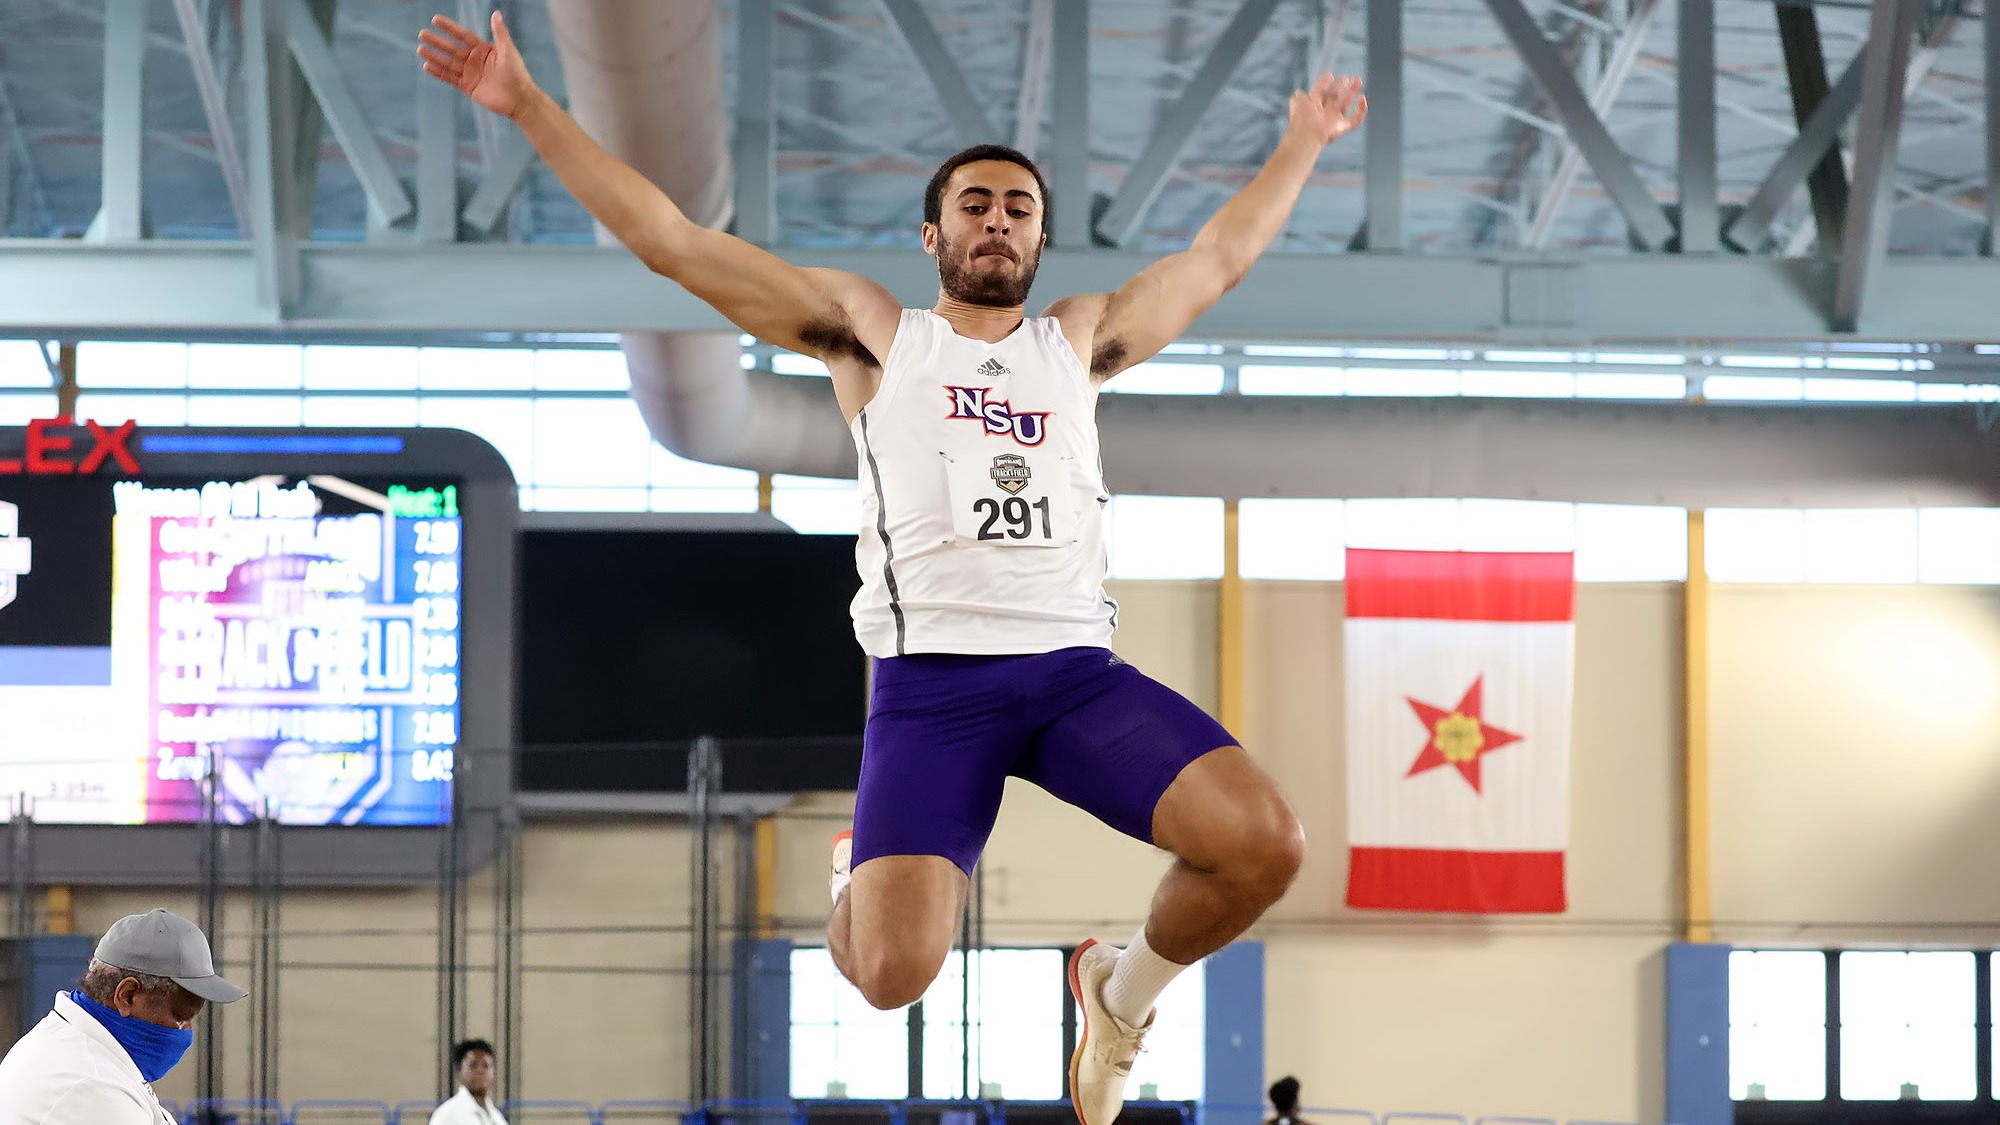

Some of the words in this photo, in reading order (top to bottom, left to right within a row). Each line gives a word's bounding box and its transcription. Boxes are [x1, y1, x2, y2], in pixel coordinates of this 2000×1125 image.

[977, 367, 1012, 377] adidas
[949, 386, 1048, 446] NSU
[973, 496, 1053, 541] 291
